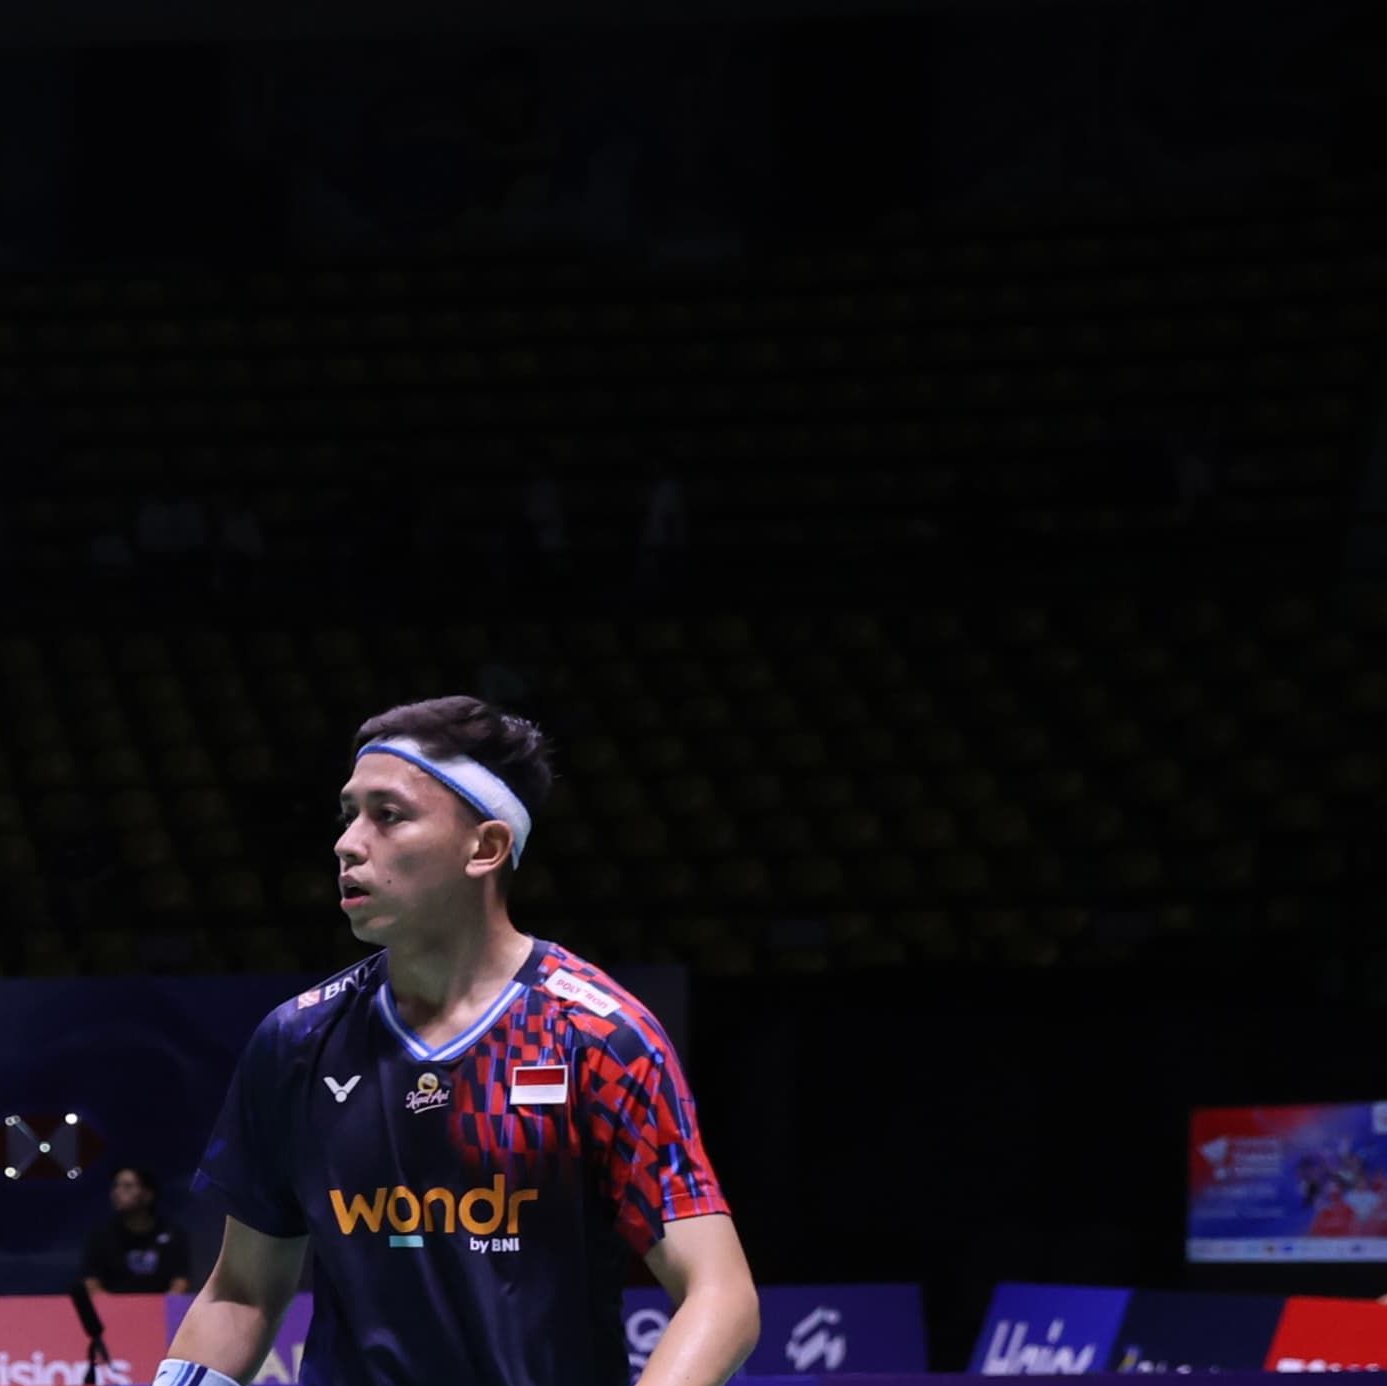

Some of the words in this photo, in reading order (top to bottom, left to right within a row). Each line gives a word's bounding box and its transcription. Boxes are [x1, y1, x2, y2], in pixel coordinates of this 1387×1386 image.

[329, 1174, 538, 1236] wondr
[470, 1238, 489, 1254] by
[491, 1238, 520, 1252] BNI
